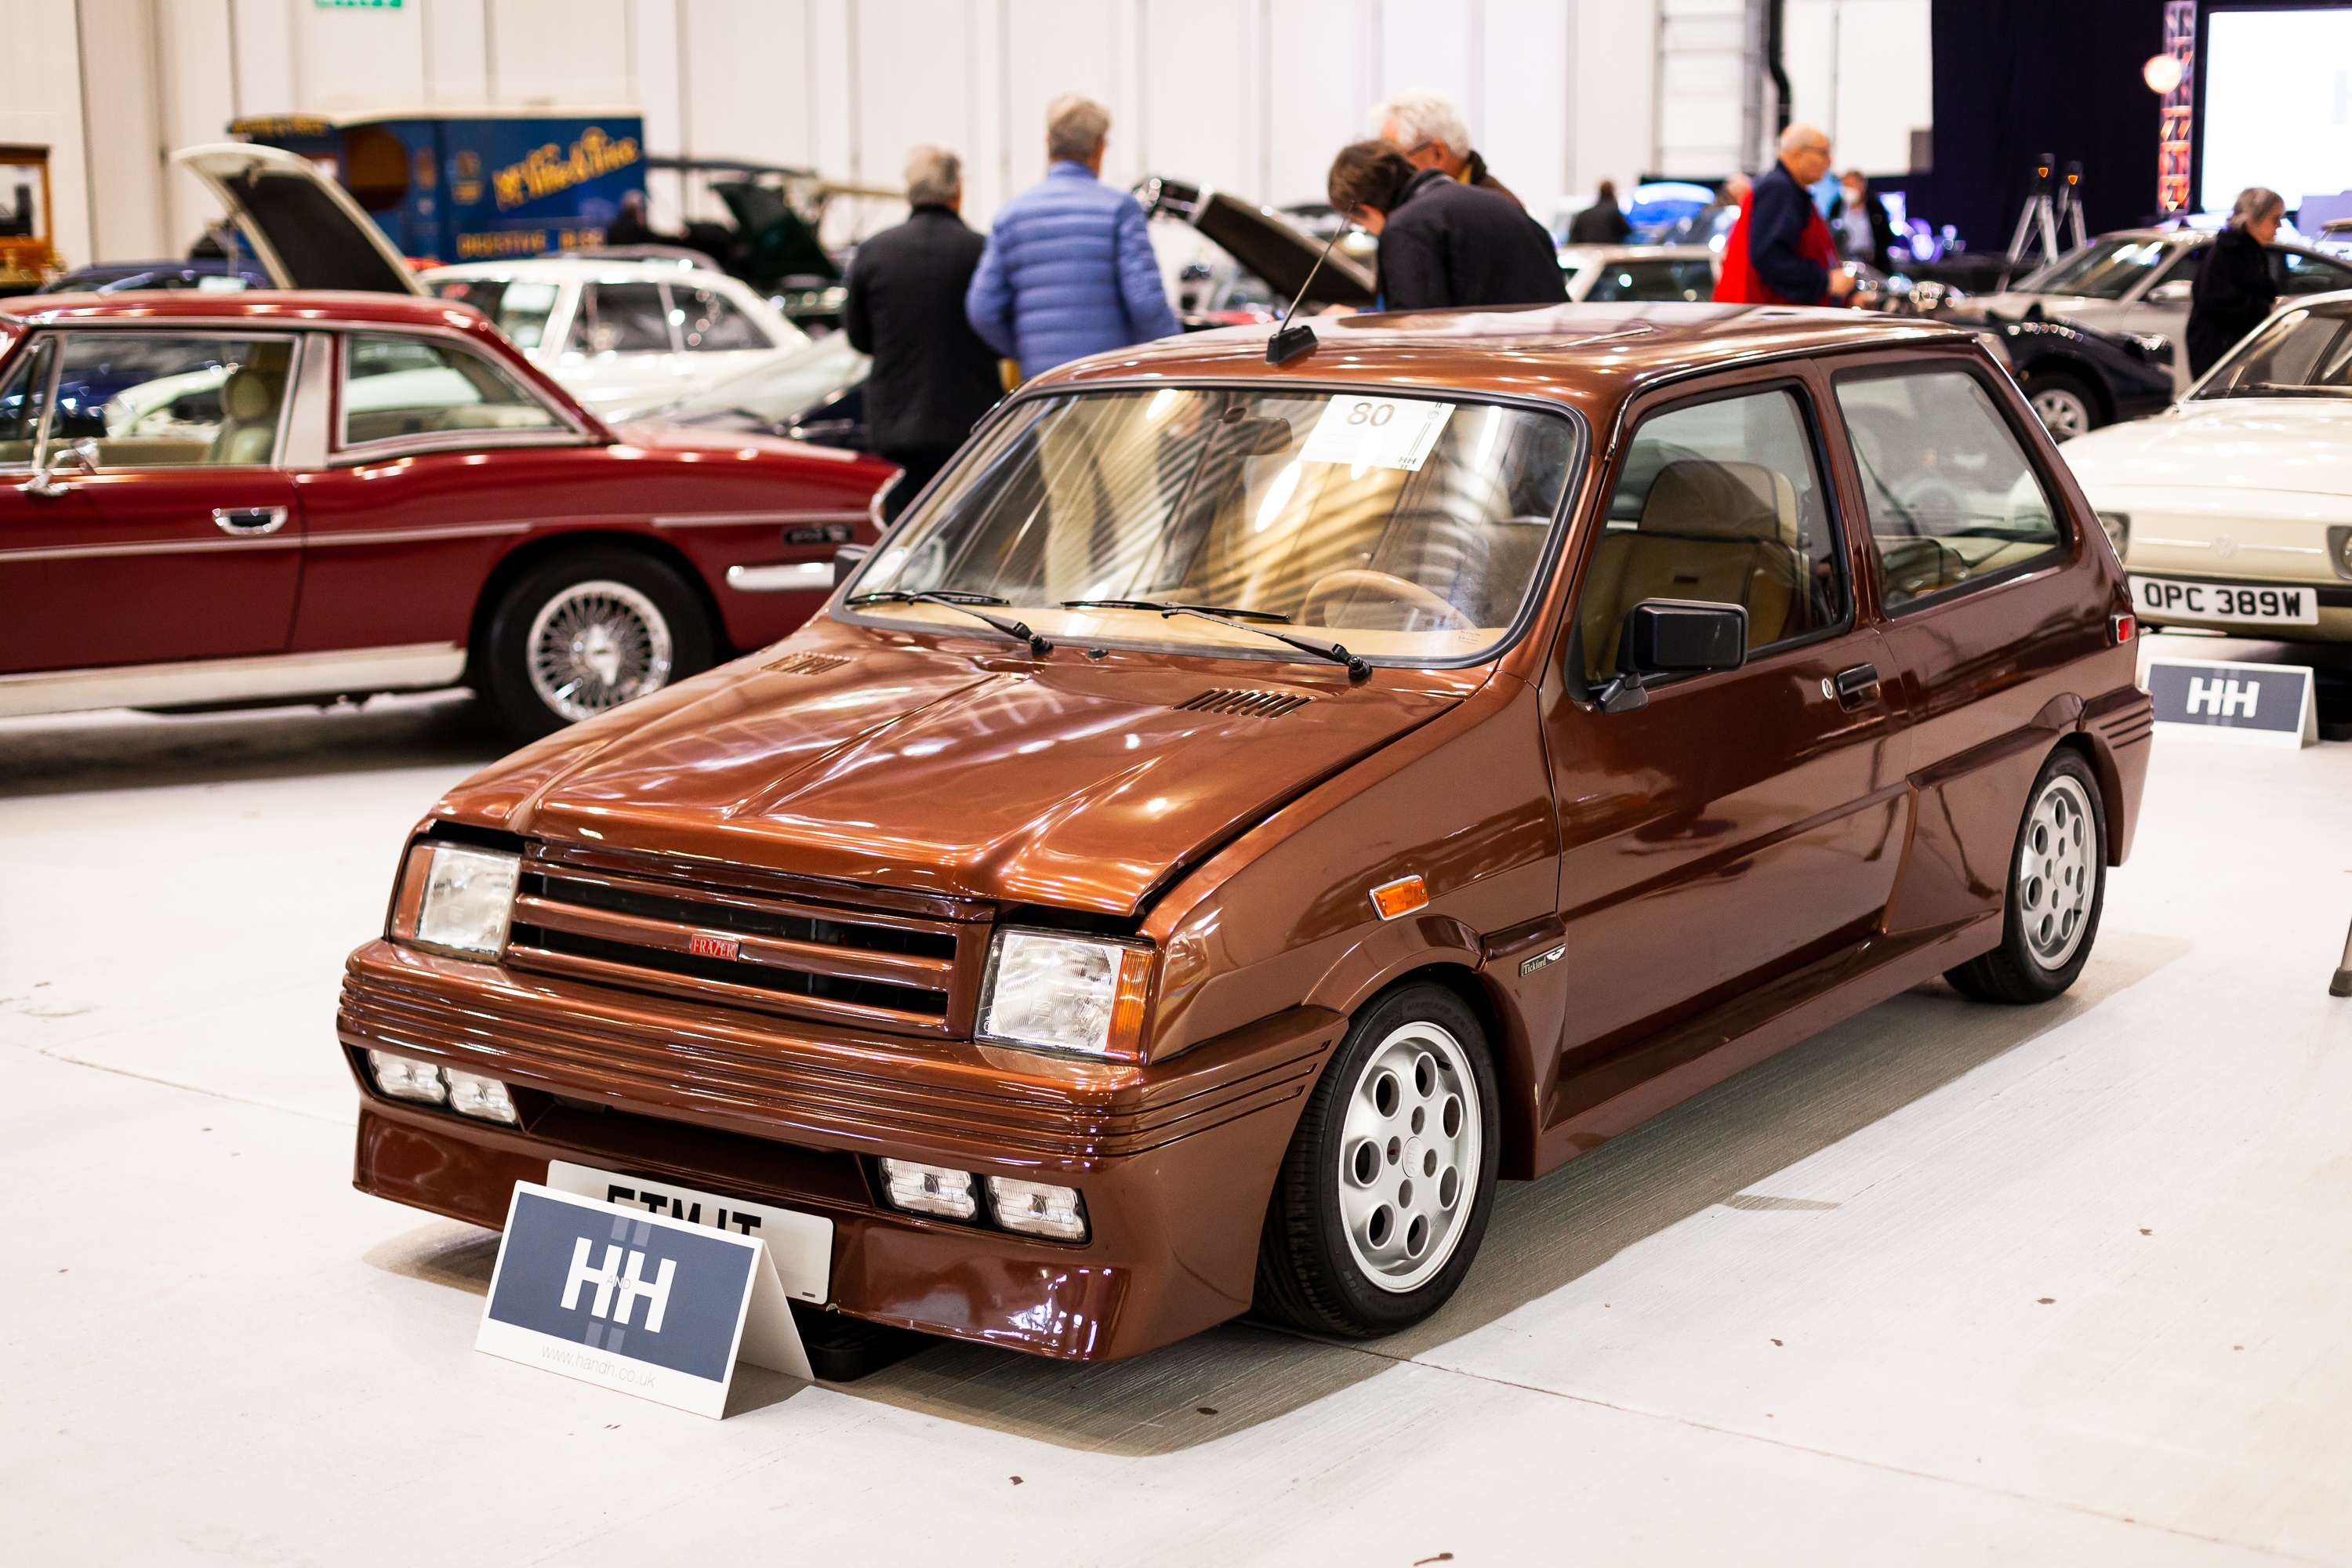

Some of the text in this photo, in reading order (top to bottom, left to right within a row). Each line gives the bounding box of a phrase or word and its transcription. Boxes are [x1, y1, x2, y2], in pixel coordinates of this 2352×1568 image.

[1347, 401, 1396, 426] 80
[2144, 583, 2301, 617] OPC 389W
[693, 938, 734, 958] FRAZER
[1523, 956, 1547, 975] Tickford
[605, 1274, 631, 1290] AND
[542, 1345, 656, 1388] www.handh.co.uk
